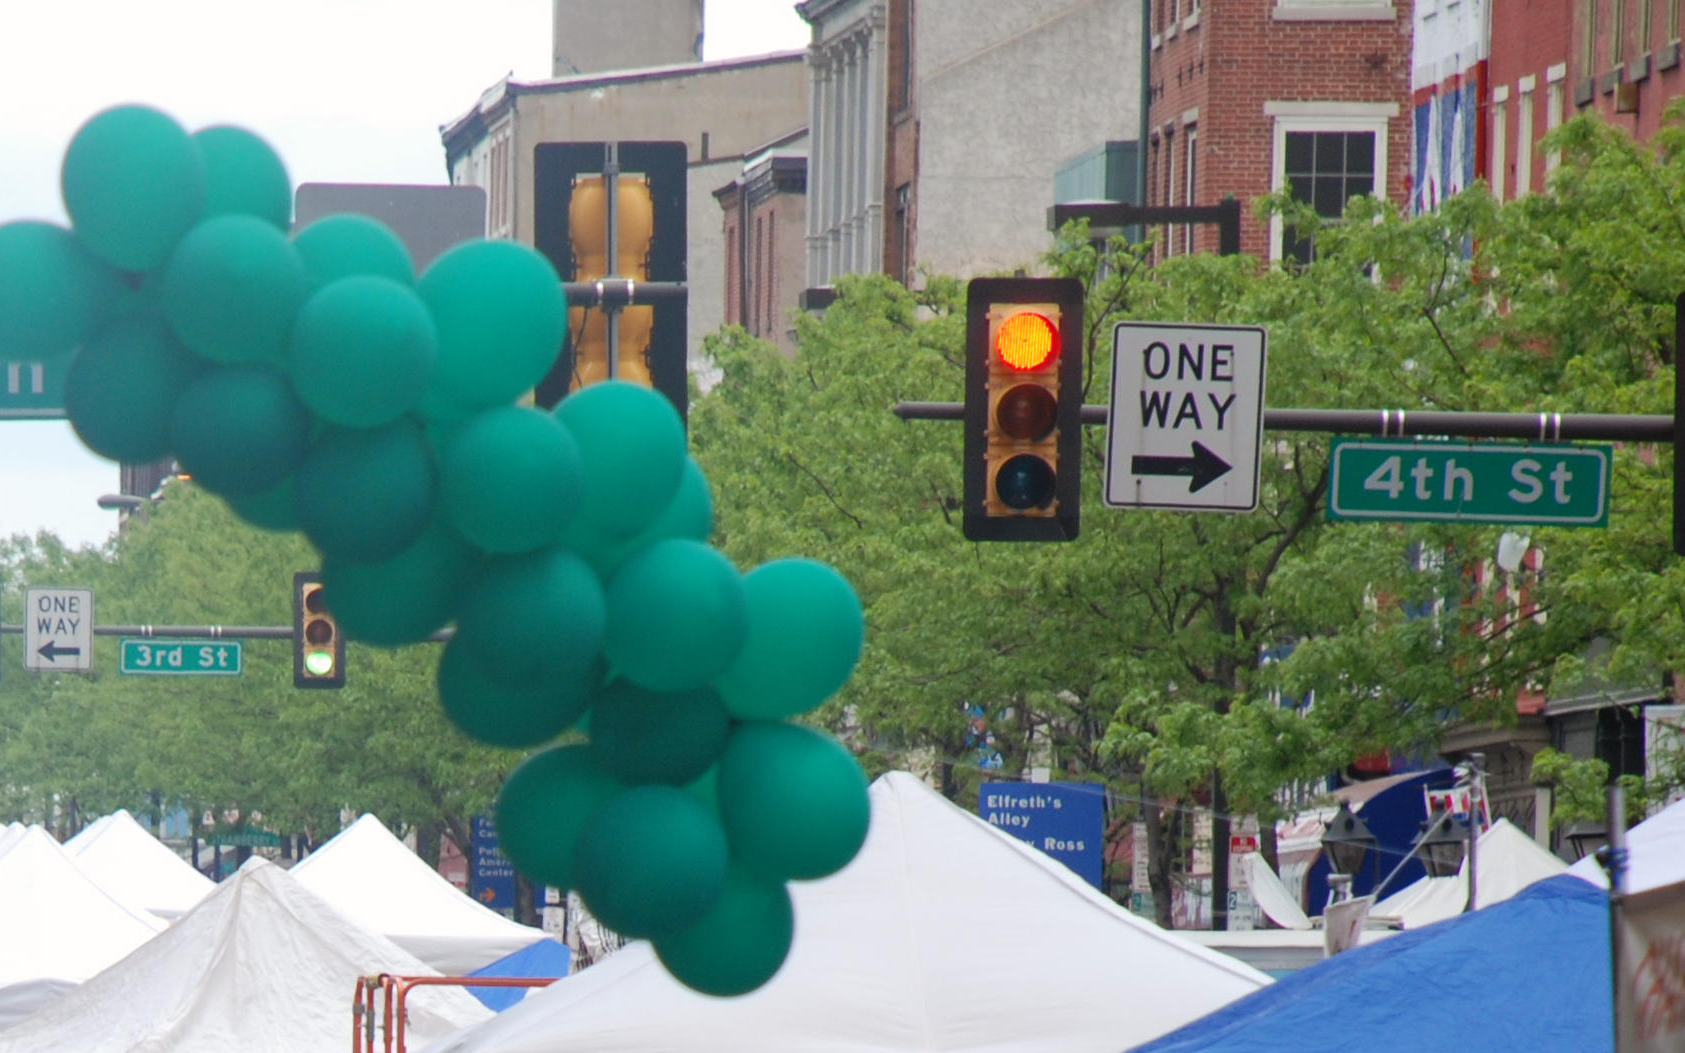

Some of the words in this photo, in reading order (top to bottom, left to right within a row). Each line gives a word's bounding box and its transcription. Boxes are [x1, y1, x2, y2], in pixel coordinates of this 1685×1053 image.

[1142, 341, 1235, 382] ONE
[1139, 390, 1237, 431] WAY
[1363, 455, 1475, 501] 4th
[1507, 458, 1574, 505] St
[37, 595, 81, 614] ONE
[36, 618, 81, 635] WAY
[135, 645, 183, 667] 3rd
[198, 647, 228, 668] St
[987, 795, 1062, 809] Elfreth's
[988, 812, 1031, 828] Alley
[1044, 837, 1085, 851] Ross
